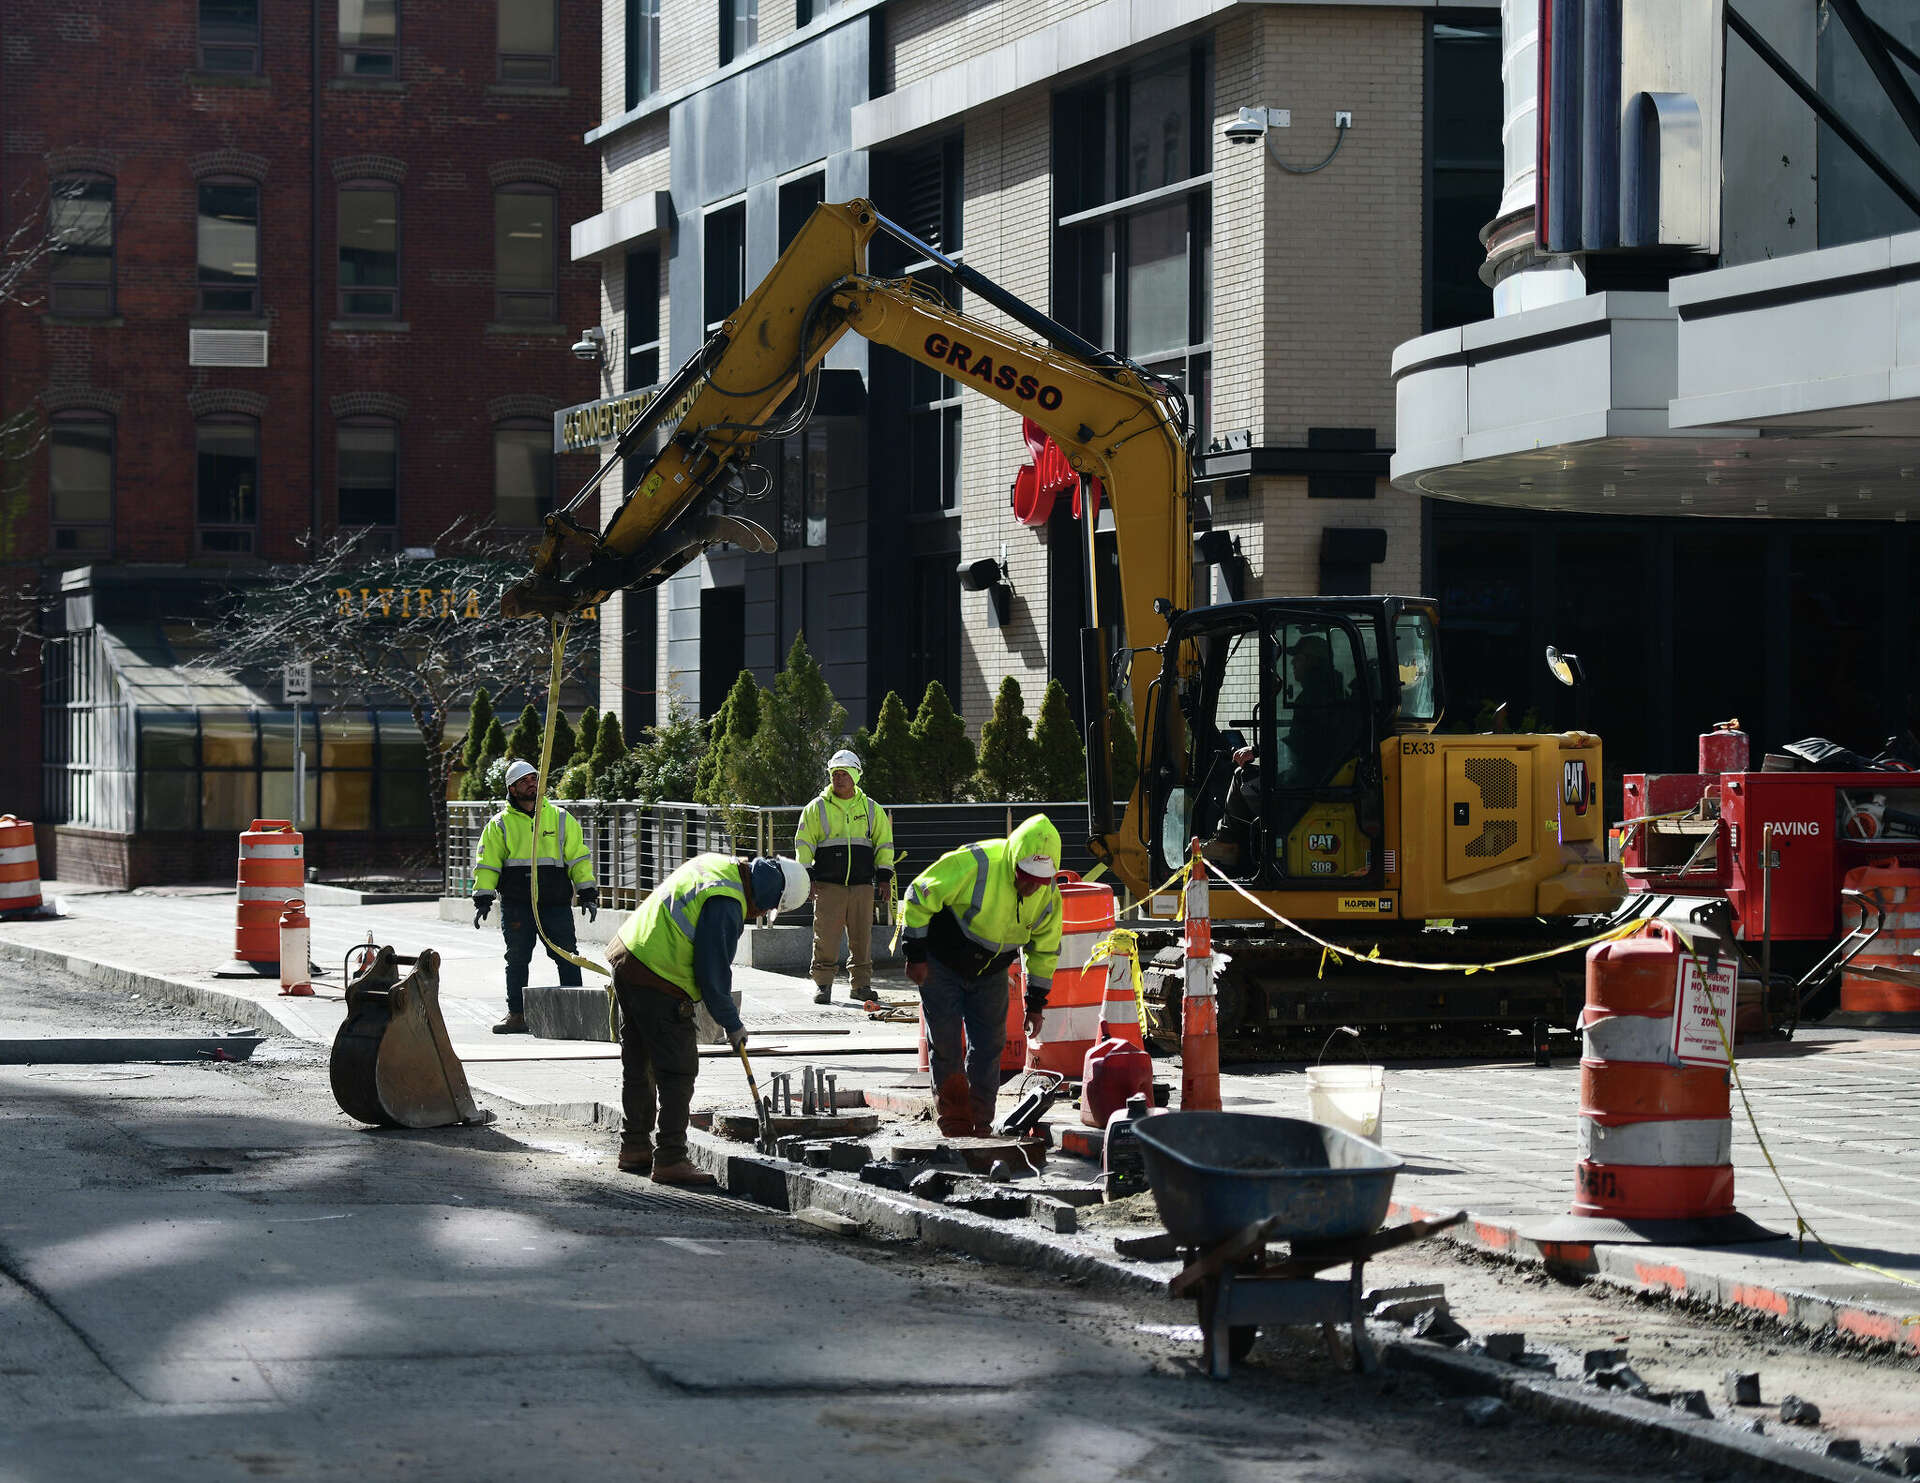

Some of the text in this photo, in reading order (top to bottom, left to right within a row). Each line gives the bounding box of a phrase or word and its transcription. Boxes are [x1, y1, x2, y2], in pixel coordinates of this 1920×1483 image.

[924, 333, 1063, 411] GRASSO
[574, 403, 614, 442] SUMMER
[336, 588, 481, 618] RIVIERA
[288, 666, 306, 677] ONE
[288, 679, 305, 687] WAY
[1402, 743, 1435, 755] EX-33
[1564, 762, 1584, 803] CAT
[1763, 821, 1820, 836] PAVING
[1309, 835, 1333, 850] CAT
[1312, 862, 1332, 873] 308
[1379, 901, 1392, 909] CAT
[1690, 982, 1703, 991] NO
[1693, 1005, 1709, 1014] TOW
